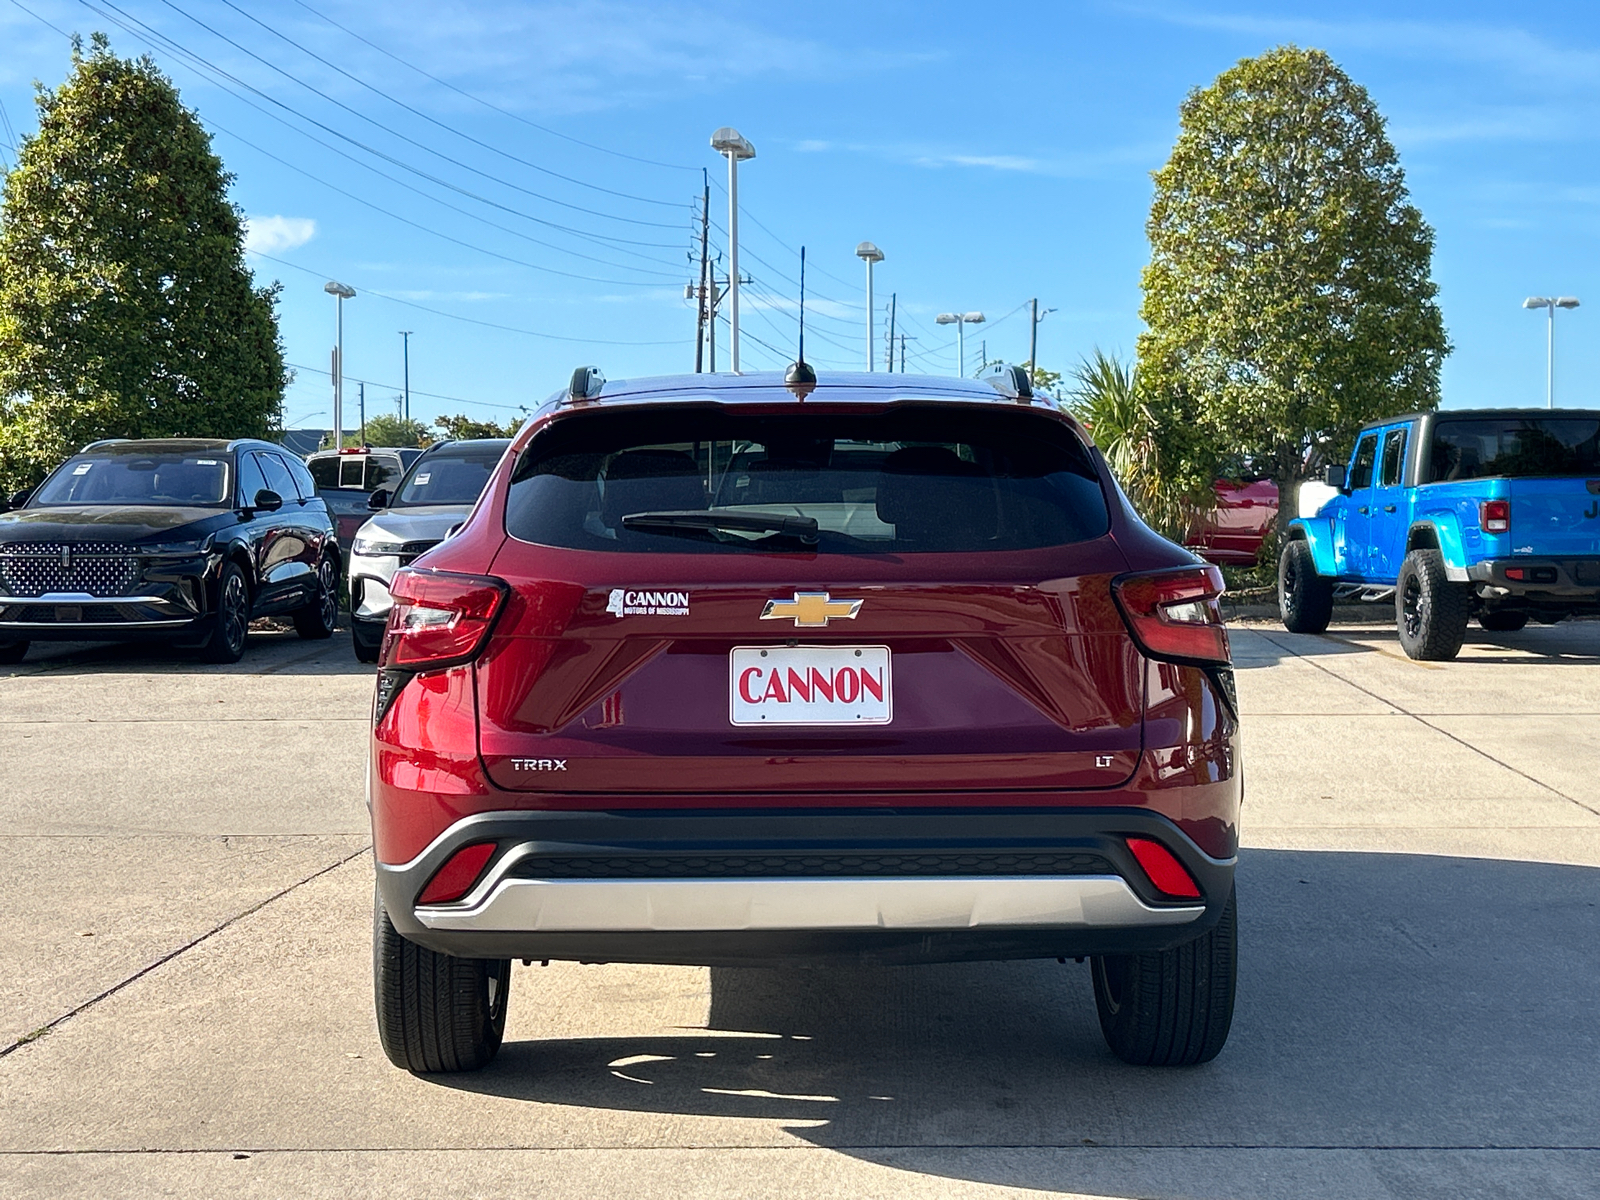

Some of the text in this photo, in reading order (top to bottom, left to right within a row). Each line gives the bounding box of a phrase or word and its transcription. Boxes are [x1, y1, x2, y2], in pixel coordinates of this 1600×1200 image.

[625, 591, 689, 606] CANNON
[739, 667, 883, 703] CANNON
[511, 759, 567, 770] TRAX
[1096, 756, 1114, 767] LT
